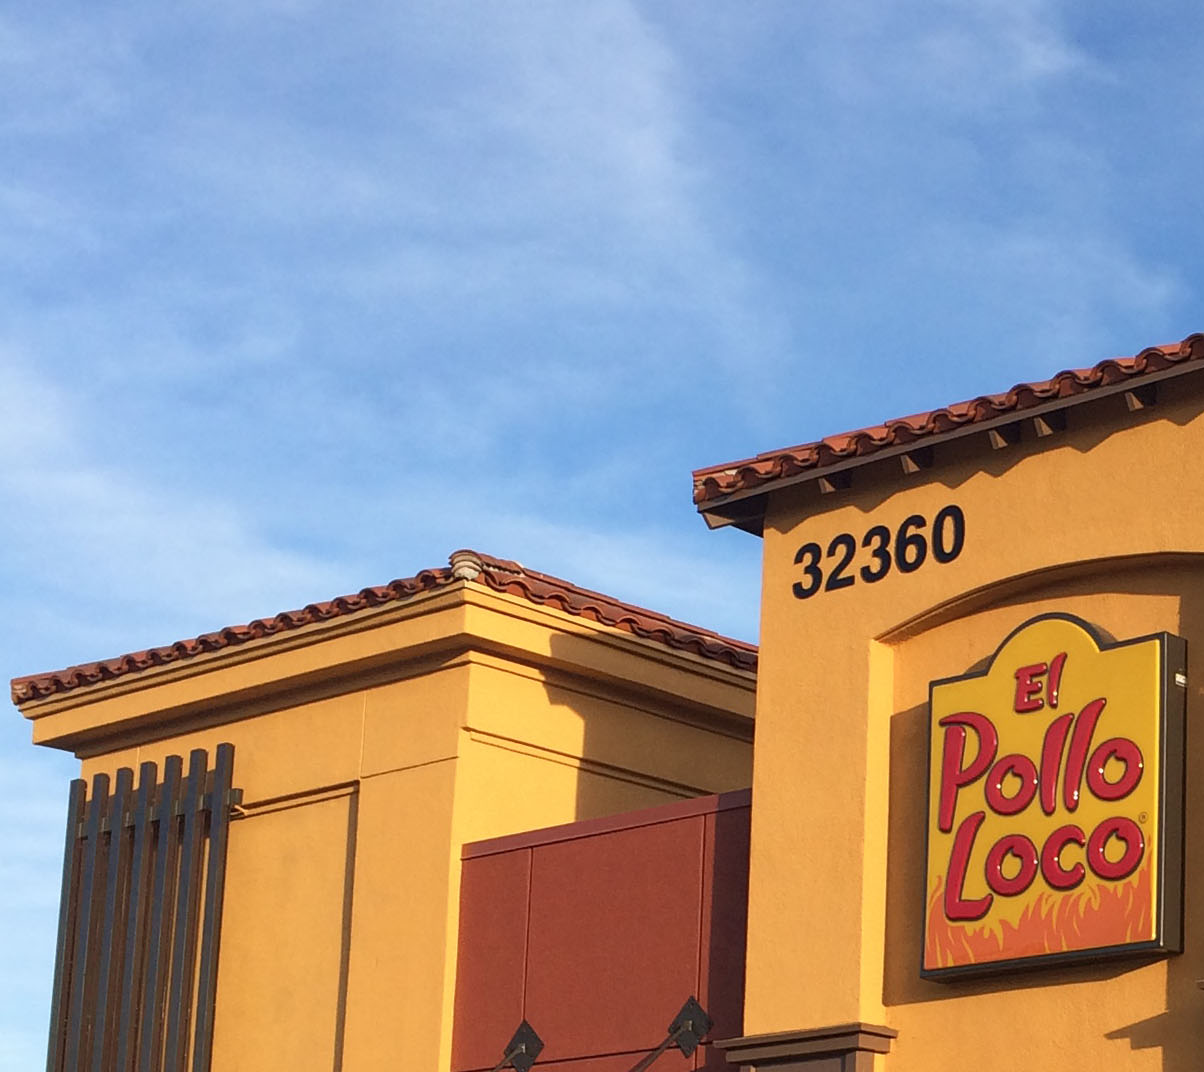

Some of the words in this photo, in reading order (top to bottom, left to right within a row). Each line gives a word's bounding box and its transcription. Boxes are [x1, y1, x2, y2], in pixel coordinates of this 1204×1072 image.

[791, 504, 966, 600] 32360
[1014, 651, 1068, 714] El
[938, 697, 1144, 834] Pollo
[944, 811, 1145, 922] Loco
